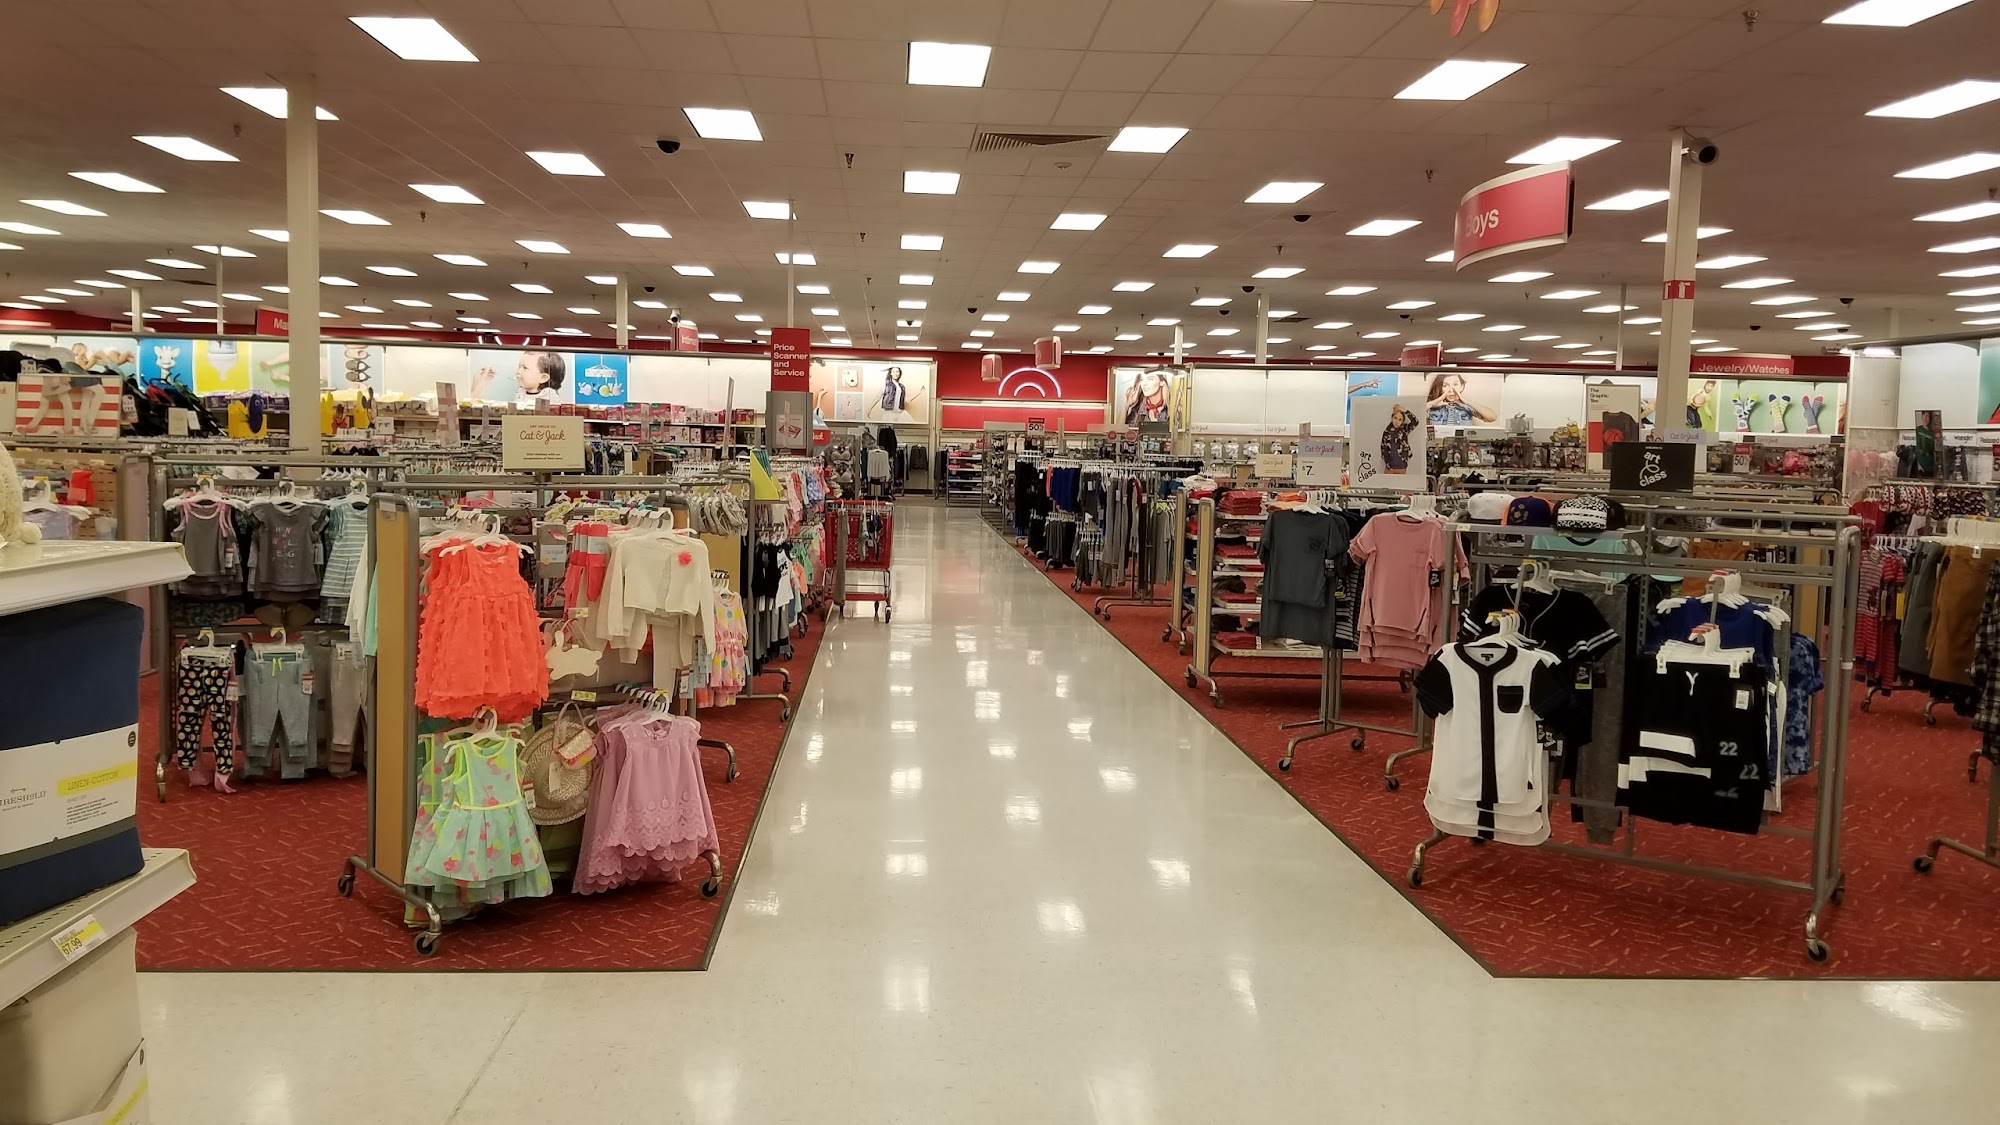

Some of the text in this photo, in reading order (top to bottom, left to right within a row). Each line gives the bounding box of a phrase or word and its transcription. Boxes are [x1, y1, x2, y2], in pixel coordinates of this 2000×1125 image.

[274, 318, 288, 330] Ma
[773, 352, 808, 360] Scanner
[1699, 364, 1790, 375] Jewelry/Watches
[520, 430, 566, 445] Cat & Jack
[1685, 432, 1700, 442] Jack
[1321, 446, 1335, 456] Jack
[1360, 450, 1372, 460] art
[1644, 452, 1661, 464] art
[1992, 458, 2000, 472] 5
[1358, 468, 1376, 482] class
[1640, 470, 1667, 487] class
[1720, 741, 1738, 756] 22
[1740, 764, 1760, 780] 22
[67, 770, 118, 791] LINEN-COTTON
[62, 938, 82, 955] 67.99
